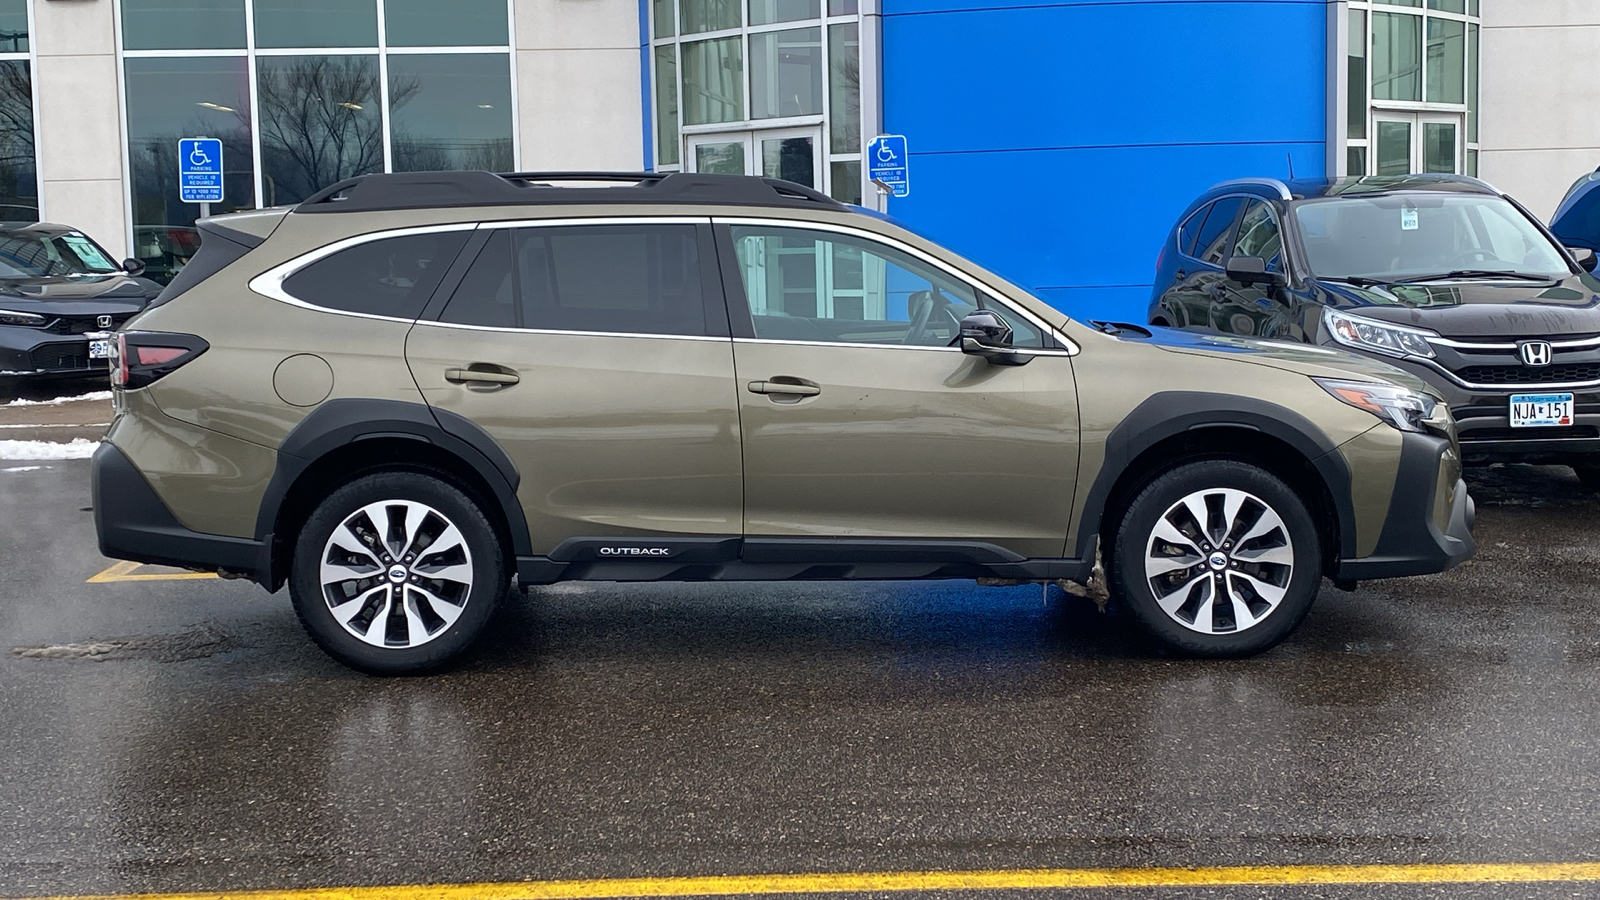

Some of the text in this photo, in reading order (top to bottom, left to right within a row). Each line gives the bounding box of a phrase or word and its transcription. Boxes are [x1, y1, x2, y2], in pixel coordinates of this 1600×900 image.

[1513, 402, 1569, 419] NJA 151
[600, 547, 669, 555] OUTBACK
